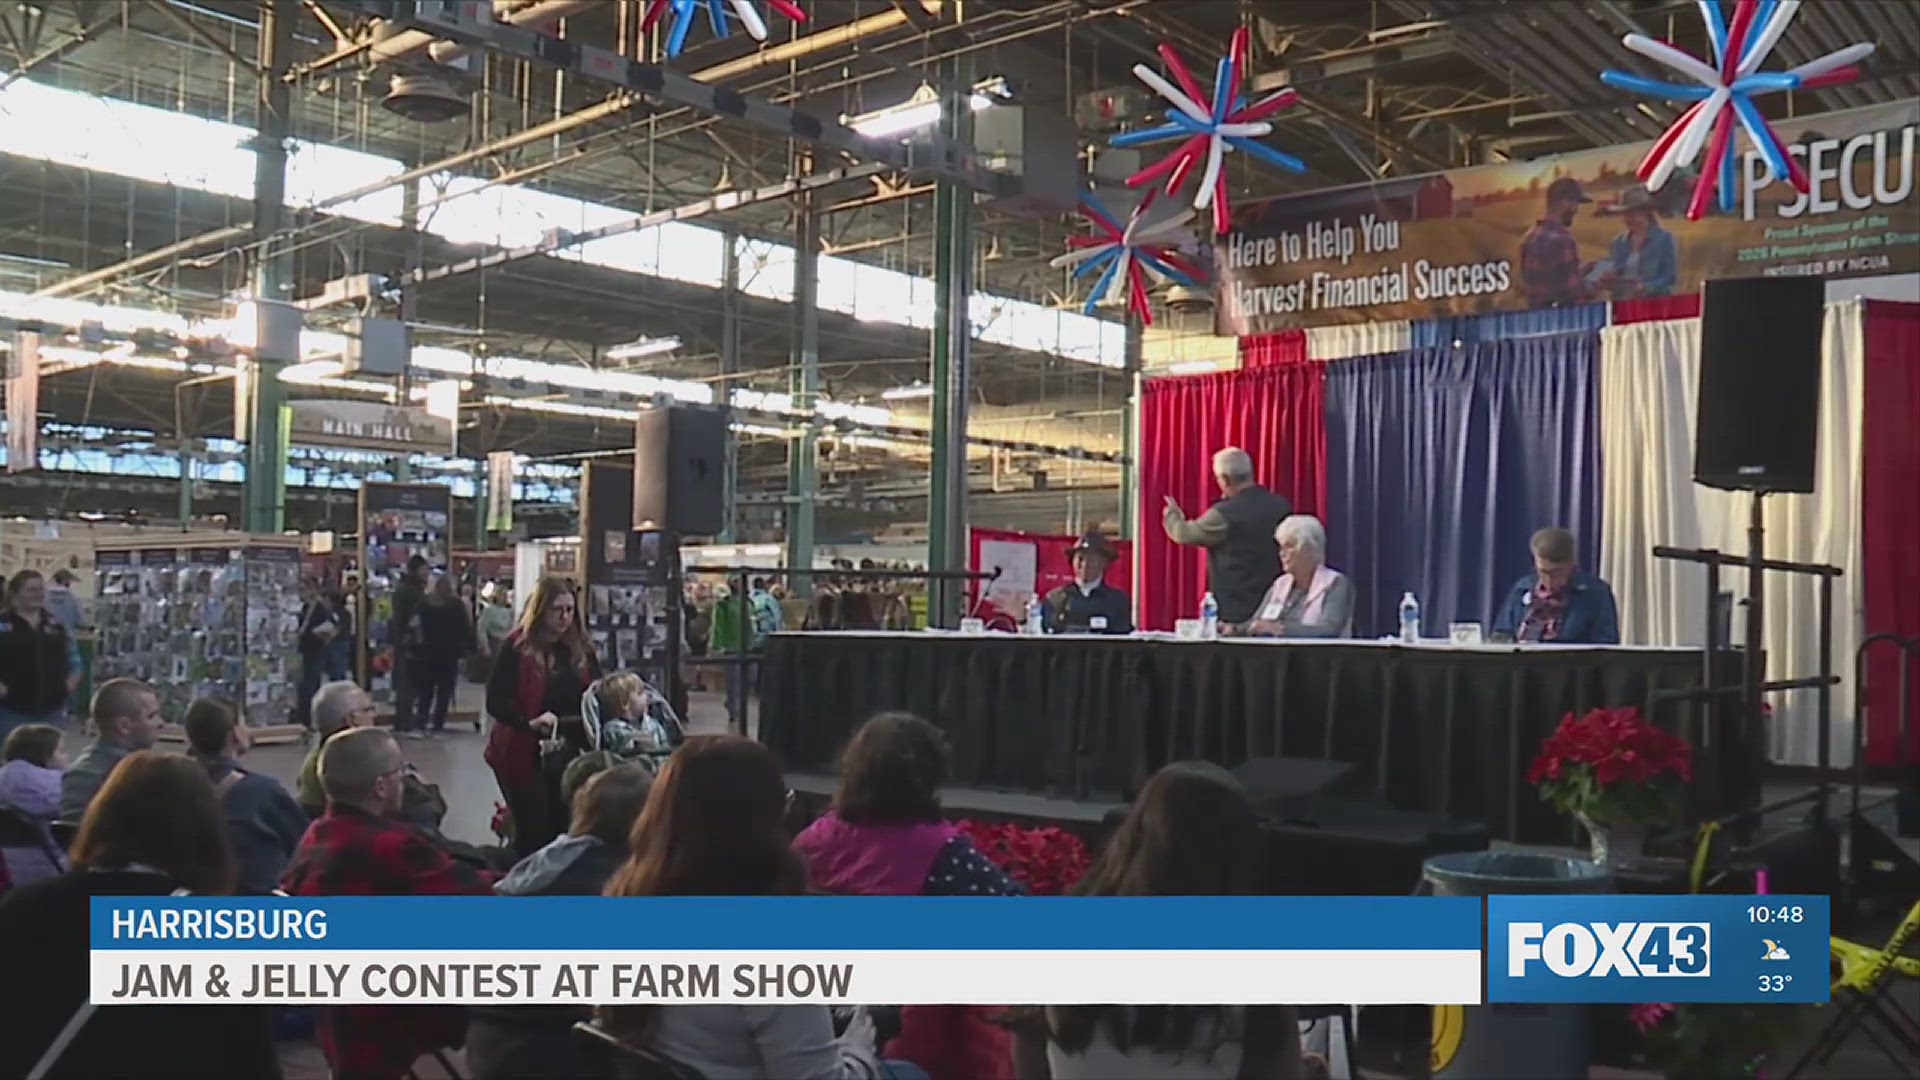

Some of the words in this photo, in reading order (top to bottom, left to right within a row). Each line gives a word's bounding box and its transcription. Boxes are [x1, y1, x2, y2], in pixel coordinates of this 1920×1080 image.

[1743, 127, 1915, 221] PSECU
[1764, 226, 1800, 240] Proud
[1801, 222, 1850, 237] Sponsor
[1852, 216, 1866, 230] of
[1867, 215, 1889, 228] the
[1228, 232, 1276, 269] Here
[1281, 230, 1300, 264] to
[1306, 218, 1355, 265] Help
[1360, 213, 1399, 253] You
[1771, 240, 1848, 258] Pennsylvania
[1850, 235, 1883, 249] Farm
[1885, 232, 1920, 246] Show
[1826, 258, 1848, 272] BY
[1230, 279, 1306, 318] Harvest
[1312, 262, 1408, 310] Financial
[1414, 259, 1511, 301] Success
[322, 418, 364, 436] MAIN
[372, 424, 412, 441] HALL
